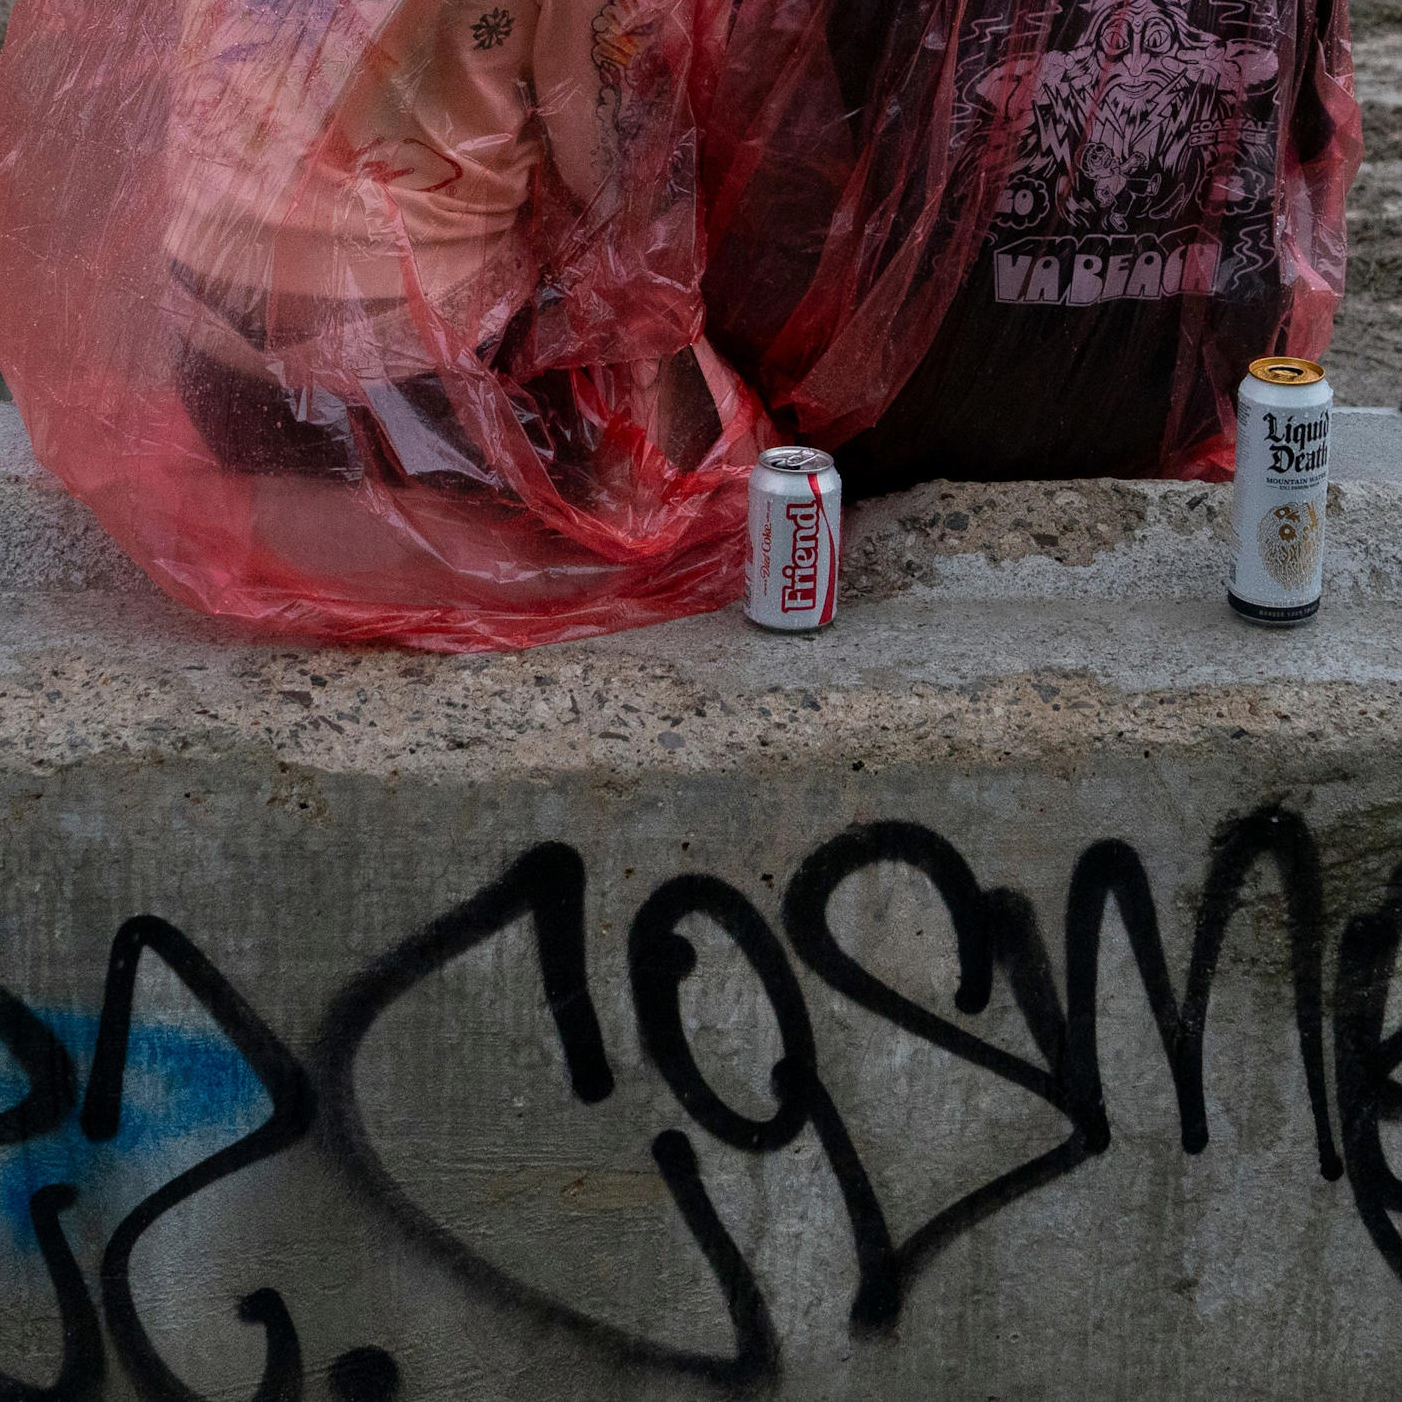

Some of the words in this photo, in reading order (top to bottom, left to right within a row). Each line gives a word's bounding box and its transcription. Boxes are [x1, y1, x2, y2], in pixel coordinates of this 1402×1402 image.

[1190, 117, 1268, 134] COASTAL
[995, 251, 1061, 302] VA
[1065, 242, 1220, 304] BEACH
[1262, 408, 1330, 453] Liquid
[1267, 440, 1328, 474] Death
[1265, 477, 1309, 486] MOUNTAIN
[761, 523, 772, 553] Coke
[781, 500, 820, 613] Friend
